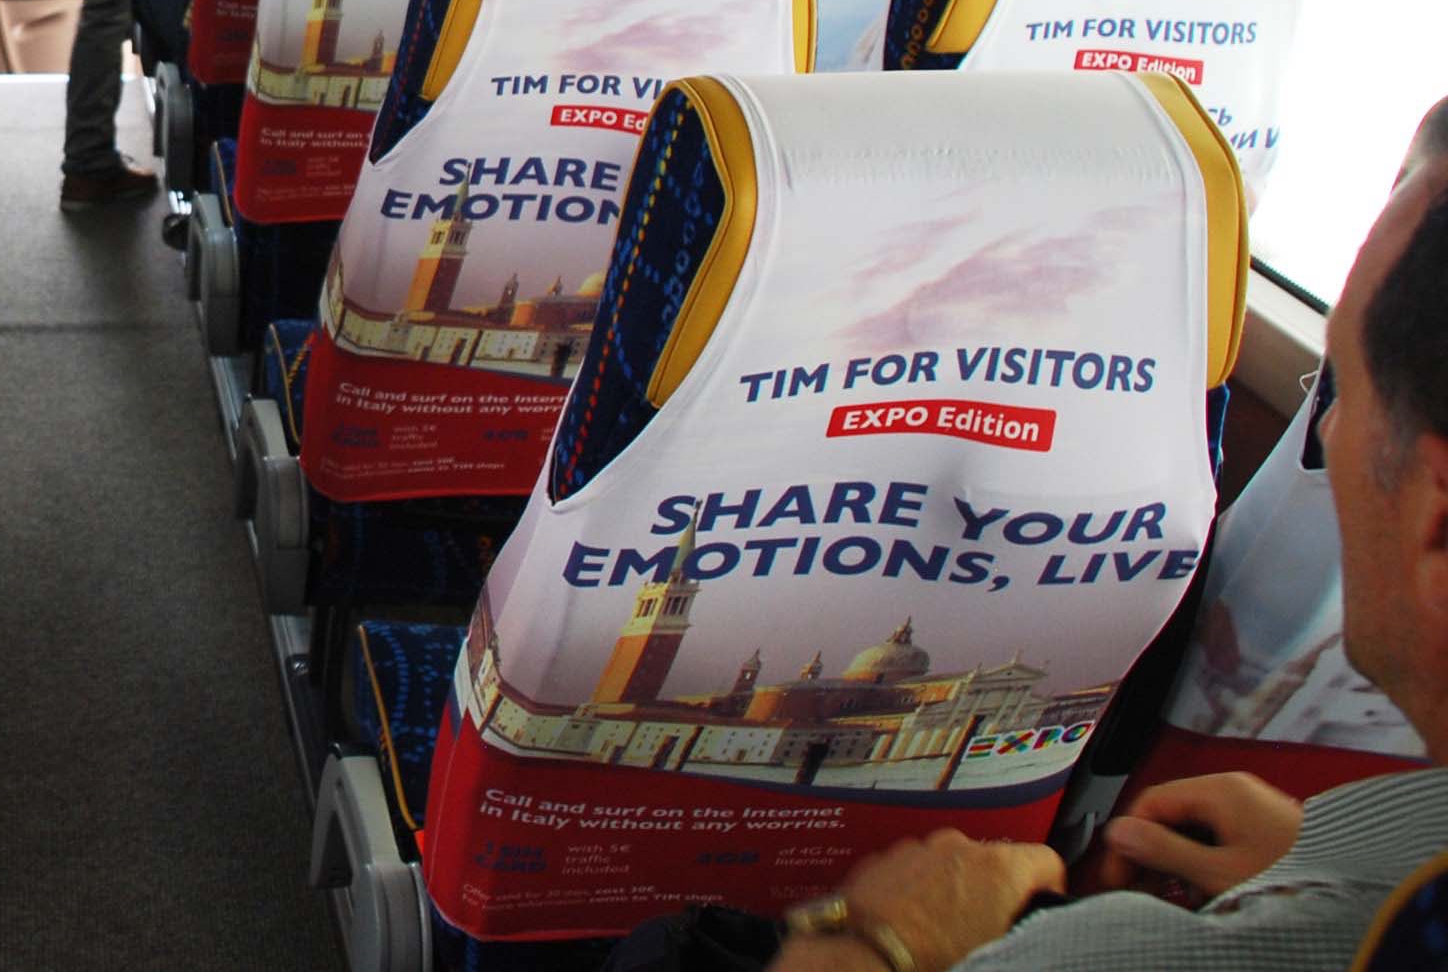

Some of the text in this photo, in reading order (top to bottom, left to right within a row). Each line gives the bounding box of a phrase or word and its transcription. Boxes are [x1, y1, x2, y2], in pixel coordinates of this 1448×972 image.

[1025, 18, 1258, 45] TIM FOR VISITORS
[1081, 51, 1132, 70] EXPO
[491, 75, 550, 96] TIM
[558, 74, 621, 96] FOR
[559, 108, 618, 125] EXPO
[439, 156, 622, 192] SHARE
[739, 346, 1156, 403] TIM FOR VISITORS
[339, 382, 371, 397] Call
[375, 390, 407, 402] and
[411, 392, 448, 403] surf
[452, 395, 474, 403] on
[479, 394, 509, 403] the
[336, 394, 352, 406] in
[356, 398, 397, 414] Italy
[402, 403, 473, 414] without
[479, 405, 512, 416] any
[841, 405, 1041, 443] EXPO Edition
[649, 480, 1167, 546] SHARE YOUR
[560, 535, 1201, 593] EMOTIONS, LIVE
[485, 788, 846, 818] Call and surf on the Internet
[479, 801, 846, 832] in Italy without any worries.
[564, 855, 610, 864] traffic
[567, 844, 604, 853] with
[561, 864, 630, 875] included
